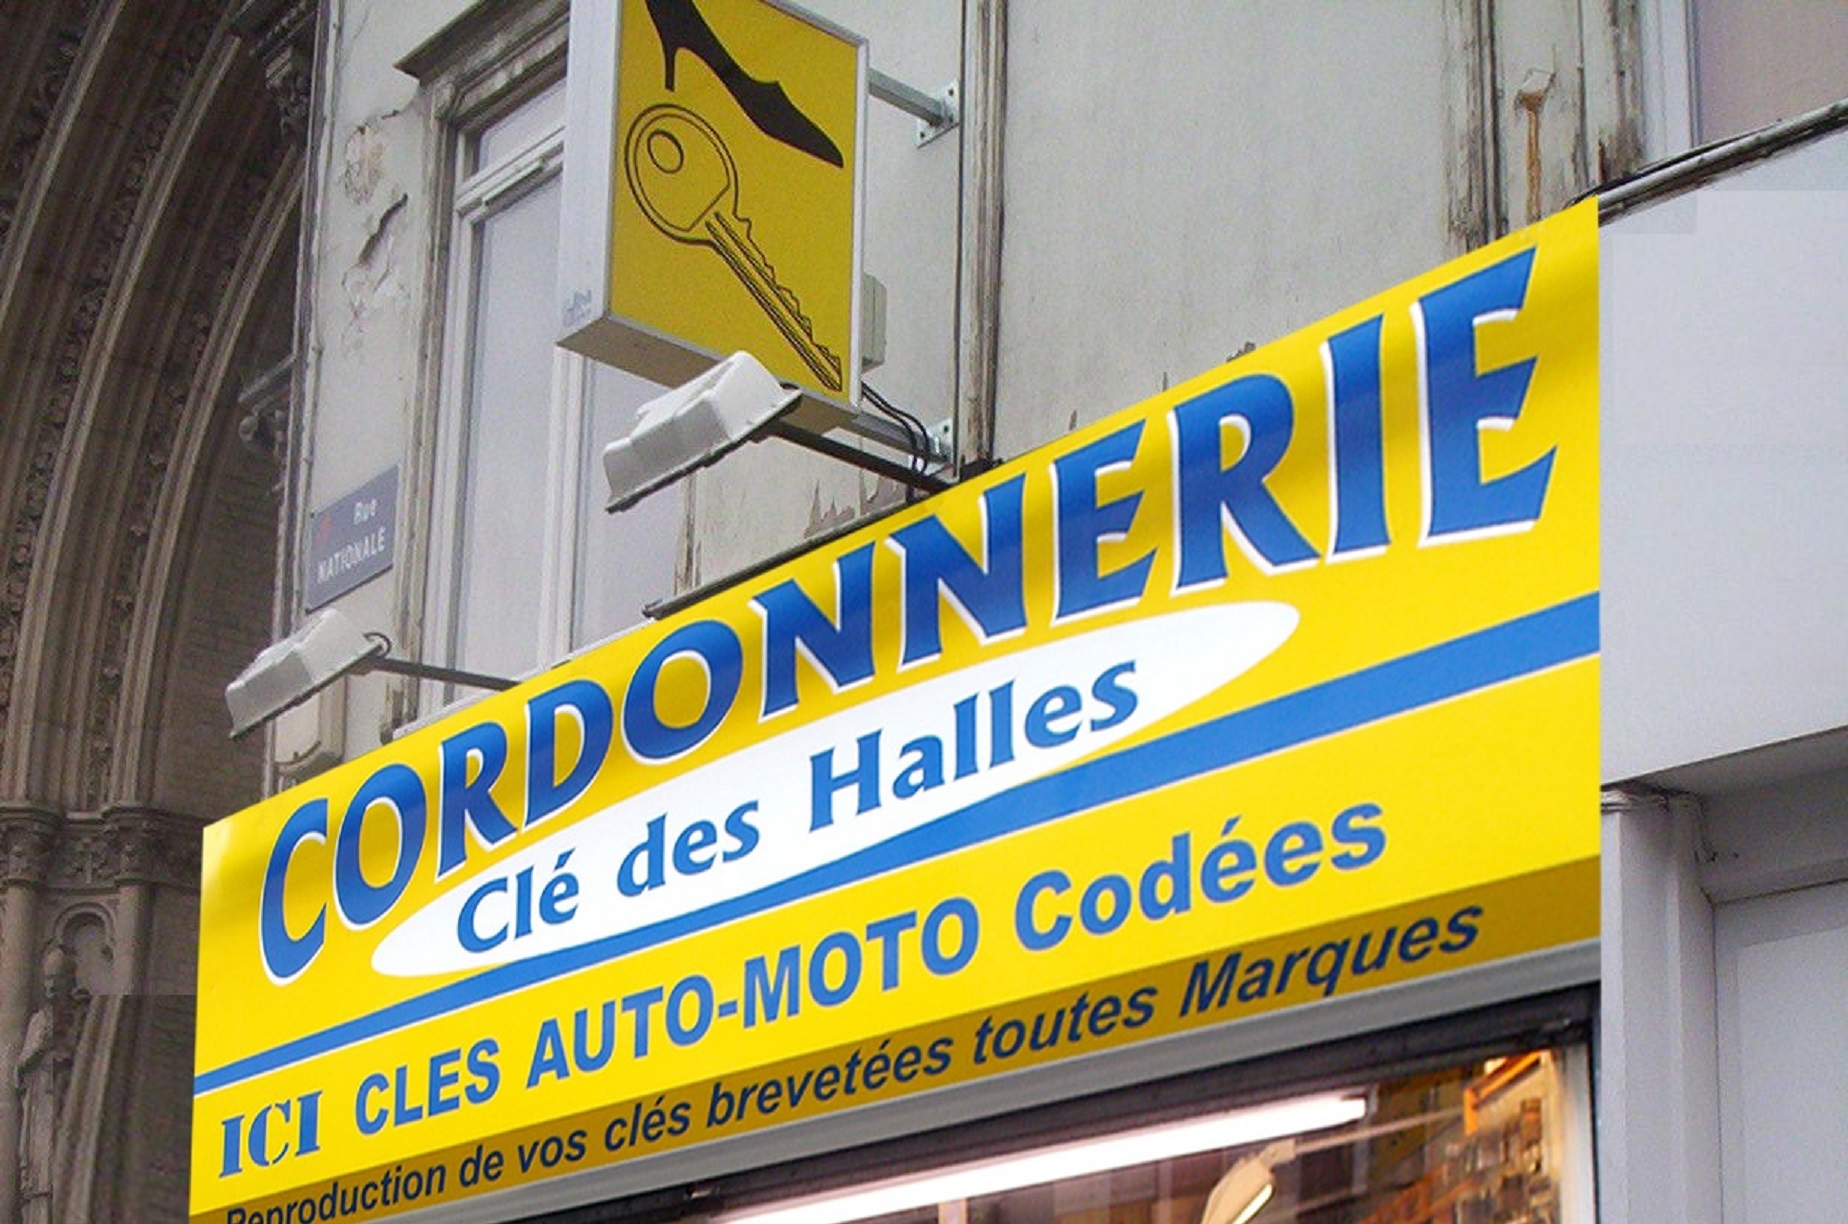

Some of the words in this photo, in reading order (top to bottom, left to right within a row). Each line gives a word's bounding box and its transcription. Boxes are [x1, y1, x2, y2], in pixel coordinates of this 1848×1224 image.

[259, 246, 1557, 986] CORDONNERIE
[317, 526, 386, 584] NATIONALE
[457, 848, 580, 954] Clé
[617, 800, 760, 899] des
[809, 659, 1140, 833] Halles
[218, 1090, 323, 1178] ICI
[354, 1038, 501, 1135] CLES
[526, 897, 979, 1089] AUTO-MOTO
[1014, 802, 1388, 952] Codées
[459, 1143, 504, 1188] de
[517, 1128, 586, 1174] vos
[604, 1093, 691, 1153] clés
[706, 1026, 953, 1128] brevetées
[974, 982, 1158, 1064] toutes
[1178, 904, 1484, 1017] Marques
